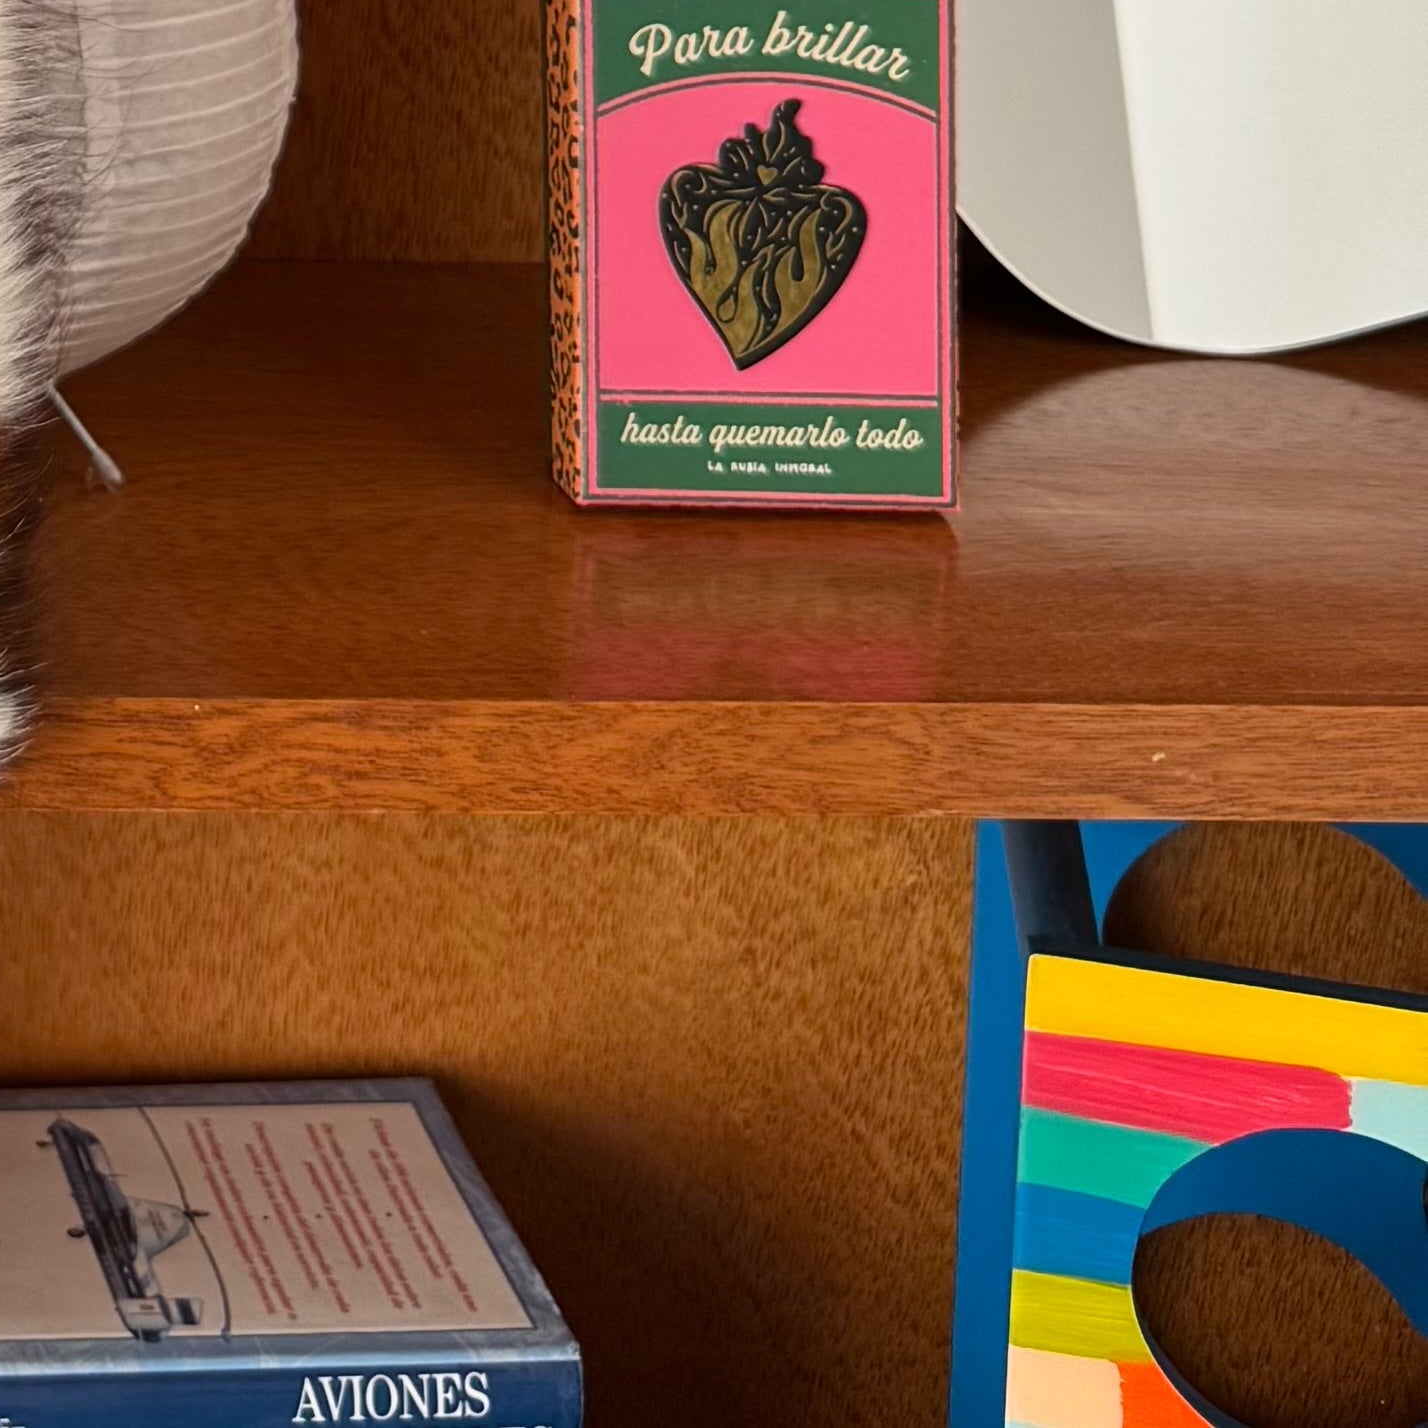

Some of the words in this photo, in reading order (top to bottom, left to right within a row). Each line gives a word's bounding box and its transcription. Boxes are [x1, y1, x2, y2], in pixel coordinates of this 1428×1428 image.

[629, 21, 755, 77] Para
[761, 10, 911, 82] brillar
[620, 411, 704, 446] hasta
[709, 415, 851, 453] quemarlo
[856, 418, 924, 451] todo
[291, 1371, 493, 1425] AVIONES
